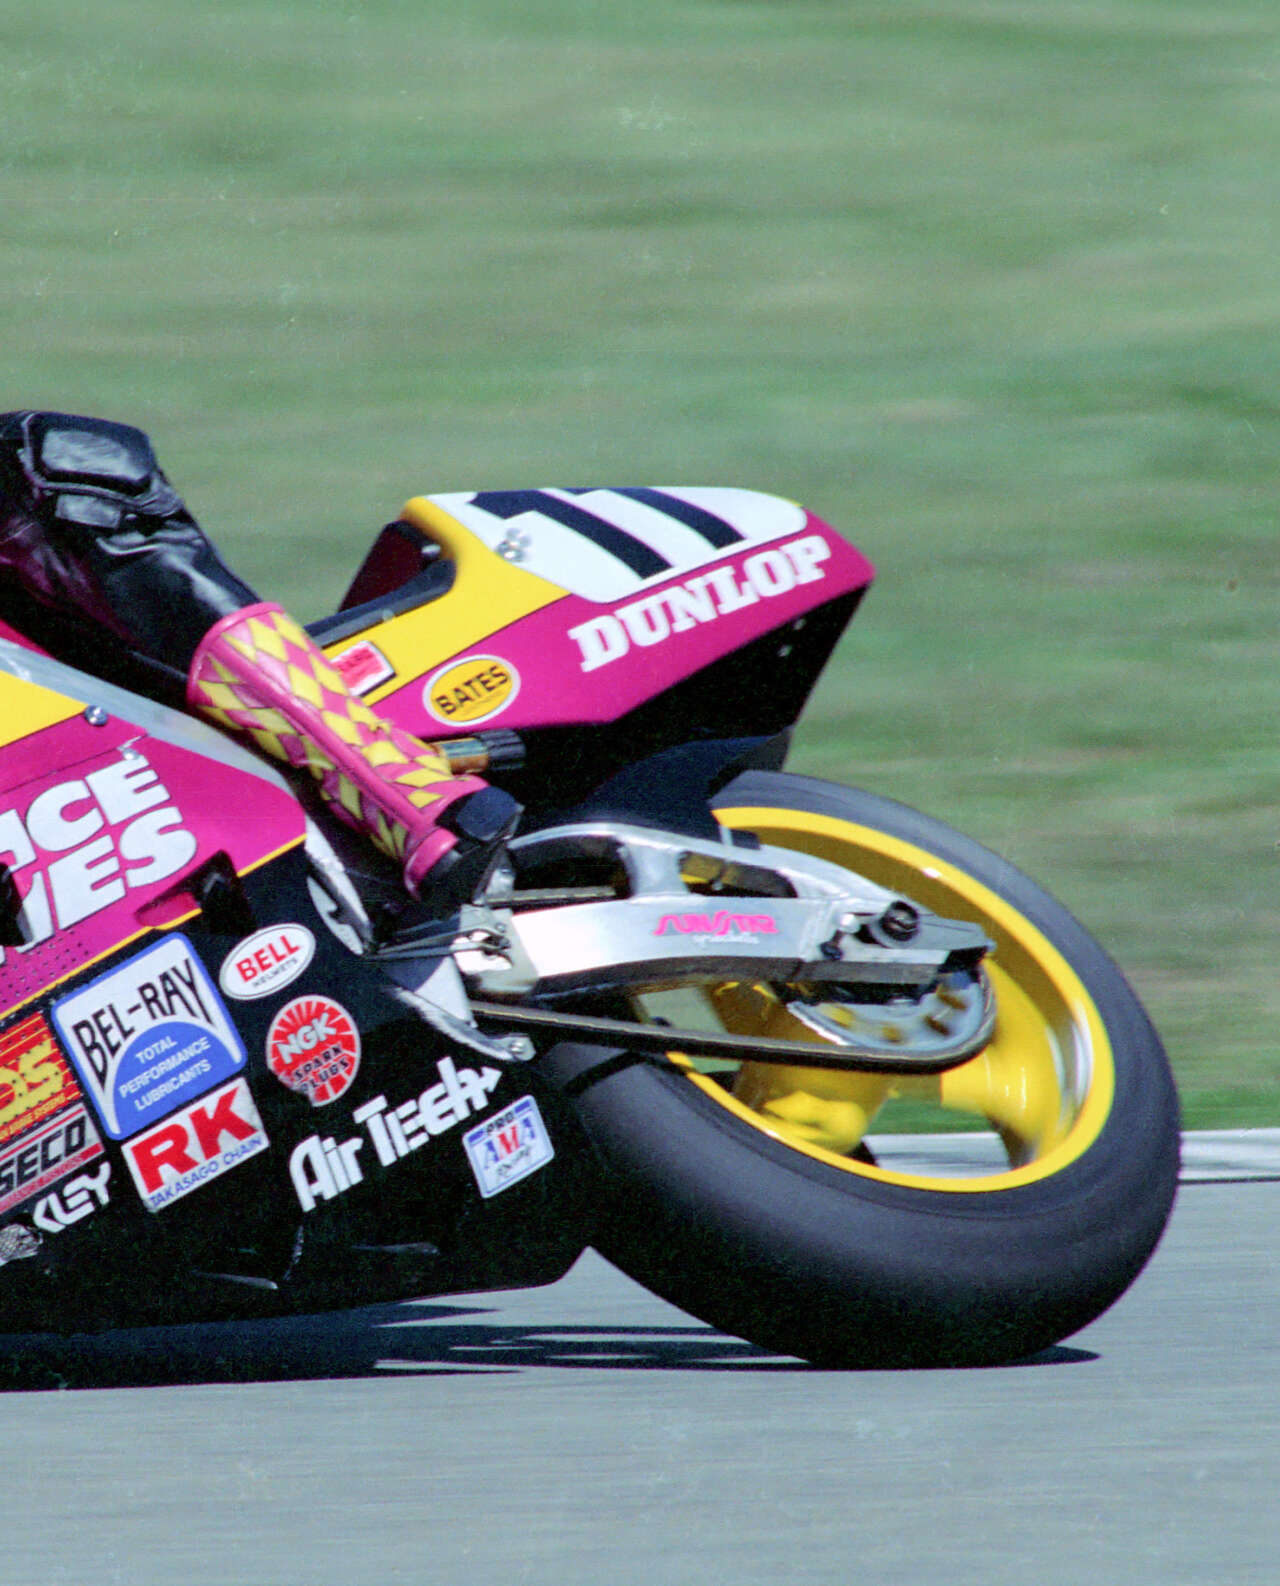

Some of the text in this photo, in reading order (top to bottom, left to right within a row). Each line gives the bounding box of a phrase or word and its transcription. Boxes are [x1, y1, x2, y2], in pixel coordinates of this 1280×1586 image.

[466, 487, 748, 581] 11
[567, 535, 831, 672] DUNLOP
[434, 665, 510, 716] BATES
[236, 934, 300, 983] BELL
[72, 959, 217, 1092] BEL-RAY
[135, 1036, 178, 1065] TOTAL
[276, 1012, 337, 1064] NGK
[119, 1036, 212, 1099] PERFORMANCE
[133, 1059, 212, 1111] LUBRICANTS
[292, 1042, 344, 1081] SPARK
[301, 1057, 349, 1092] PLUGS
[129, 1086, 260, 1194] RK
[484, 1117, 537, 1170] AMA
[485, 1111, 514, 1135] PRO
[149, 1136, 262, 1208] TAKASAGO CHAIN
